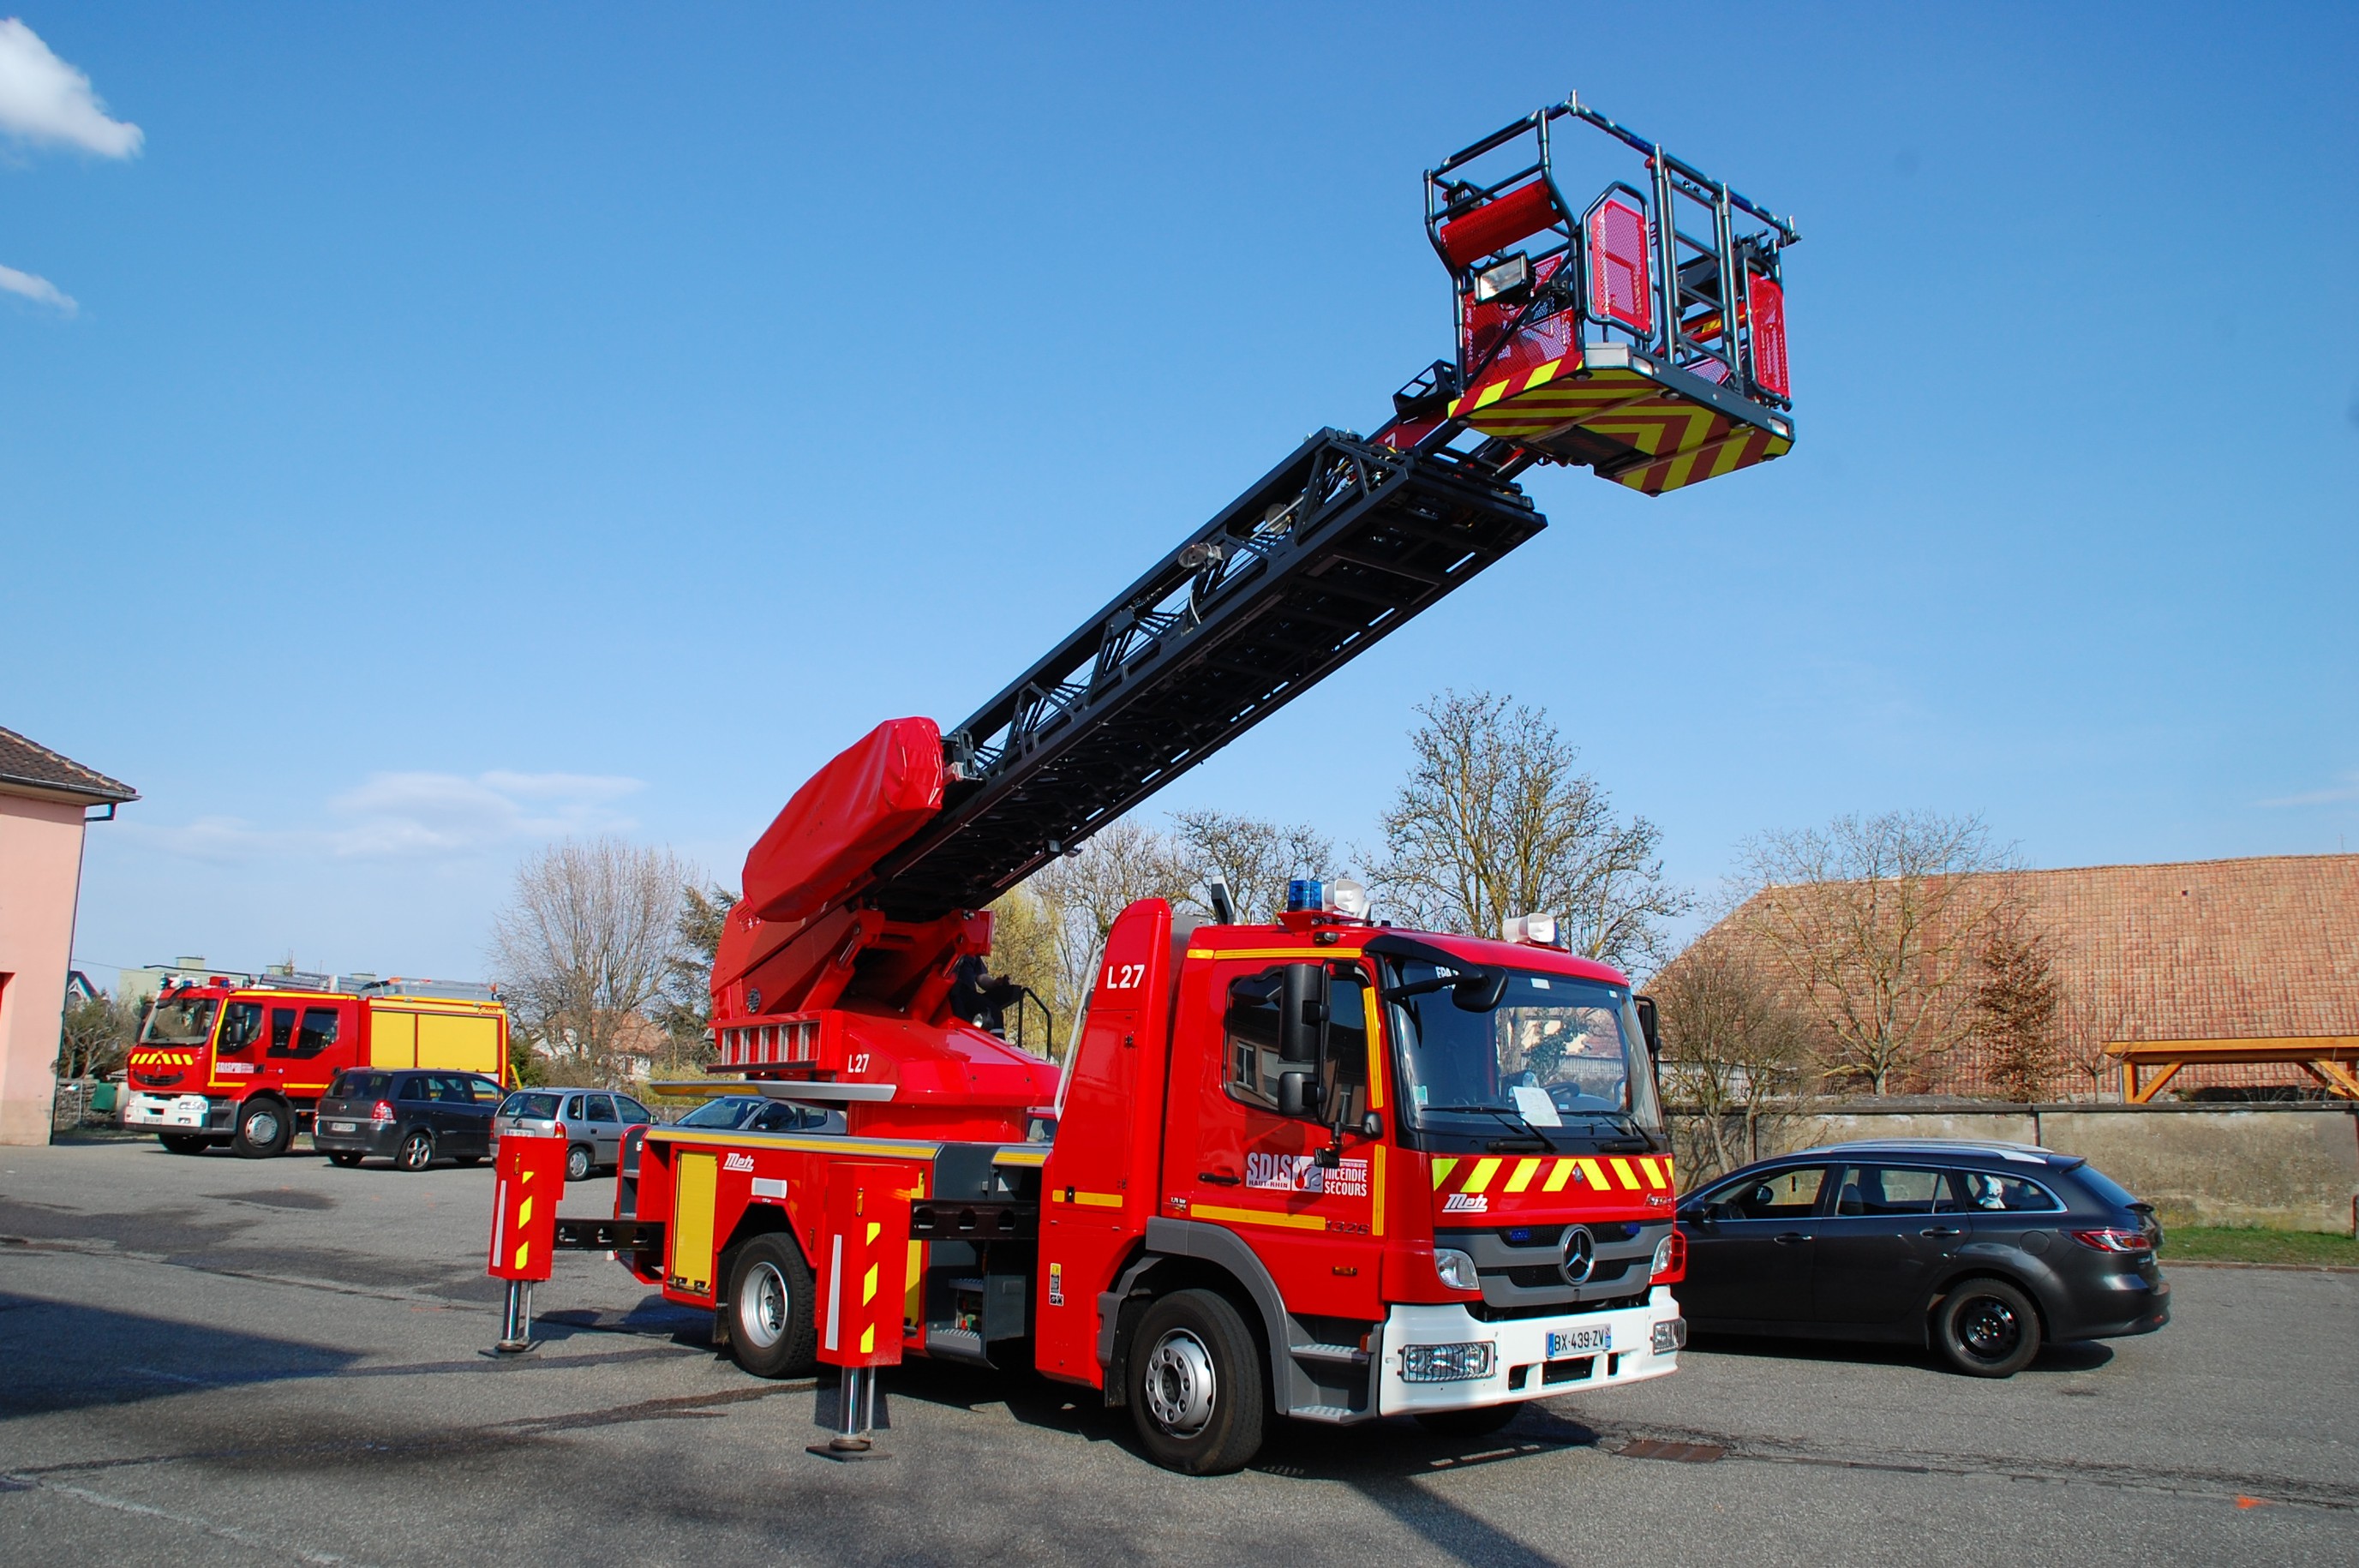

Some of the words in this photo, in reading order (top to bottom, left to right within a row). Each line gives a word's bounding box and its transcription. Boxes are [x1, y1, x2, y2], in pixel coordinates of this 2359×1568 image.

[1107, 964, 1145, 989] L27
[847, 1054, 870, 1073] L27
[722, 1152, 754, 1172] Metz
[1247, 1152, 1291, 1182] SDIS
[1324, 1181, 1368, 1197] SECOURS
[1442, 1194, 1488, 1213] Metz
[1326, 1220, 1369, 1235] 1326
